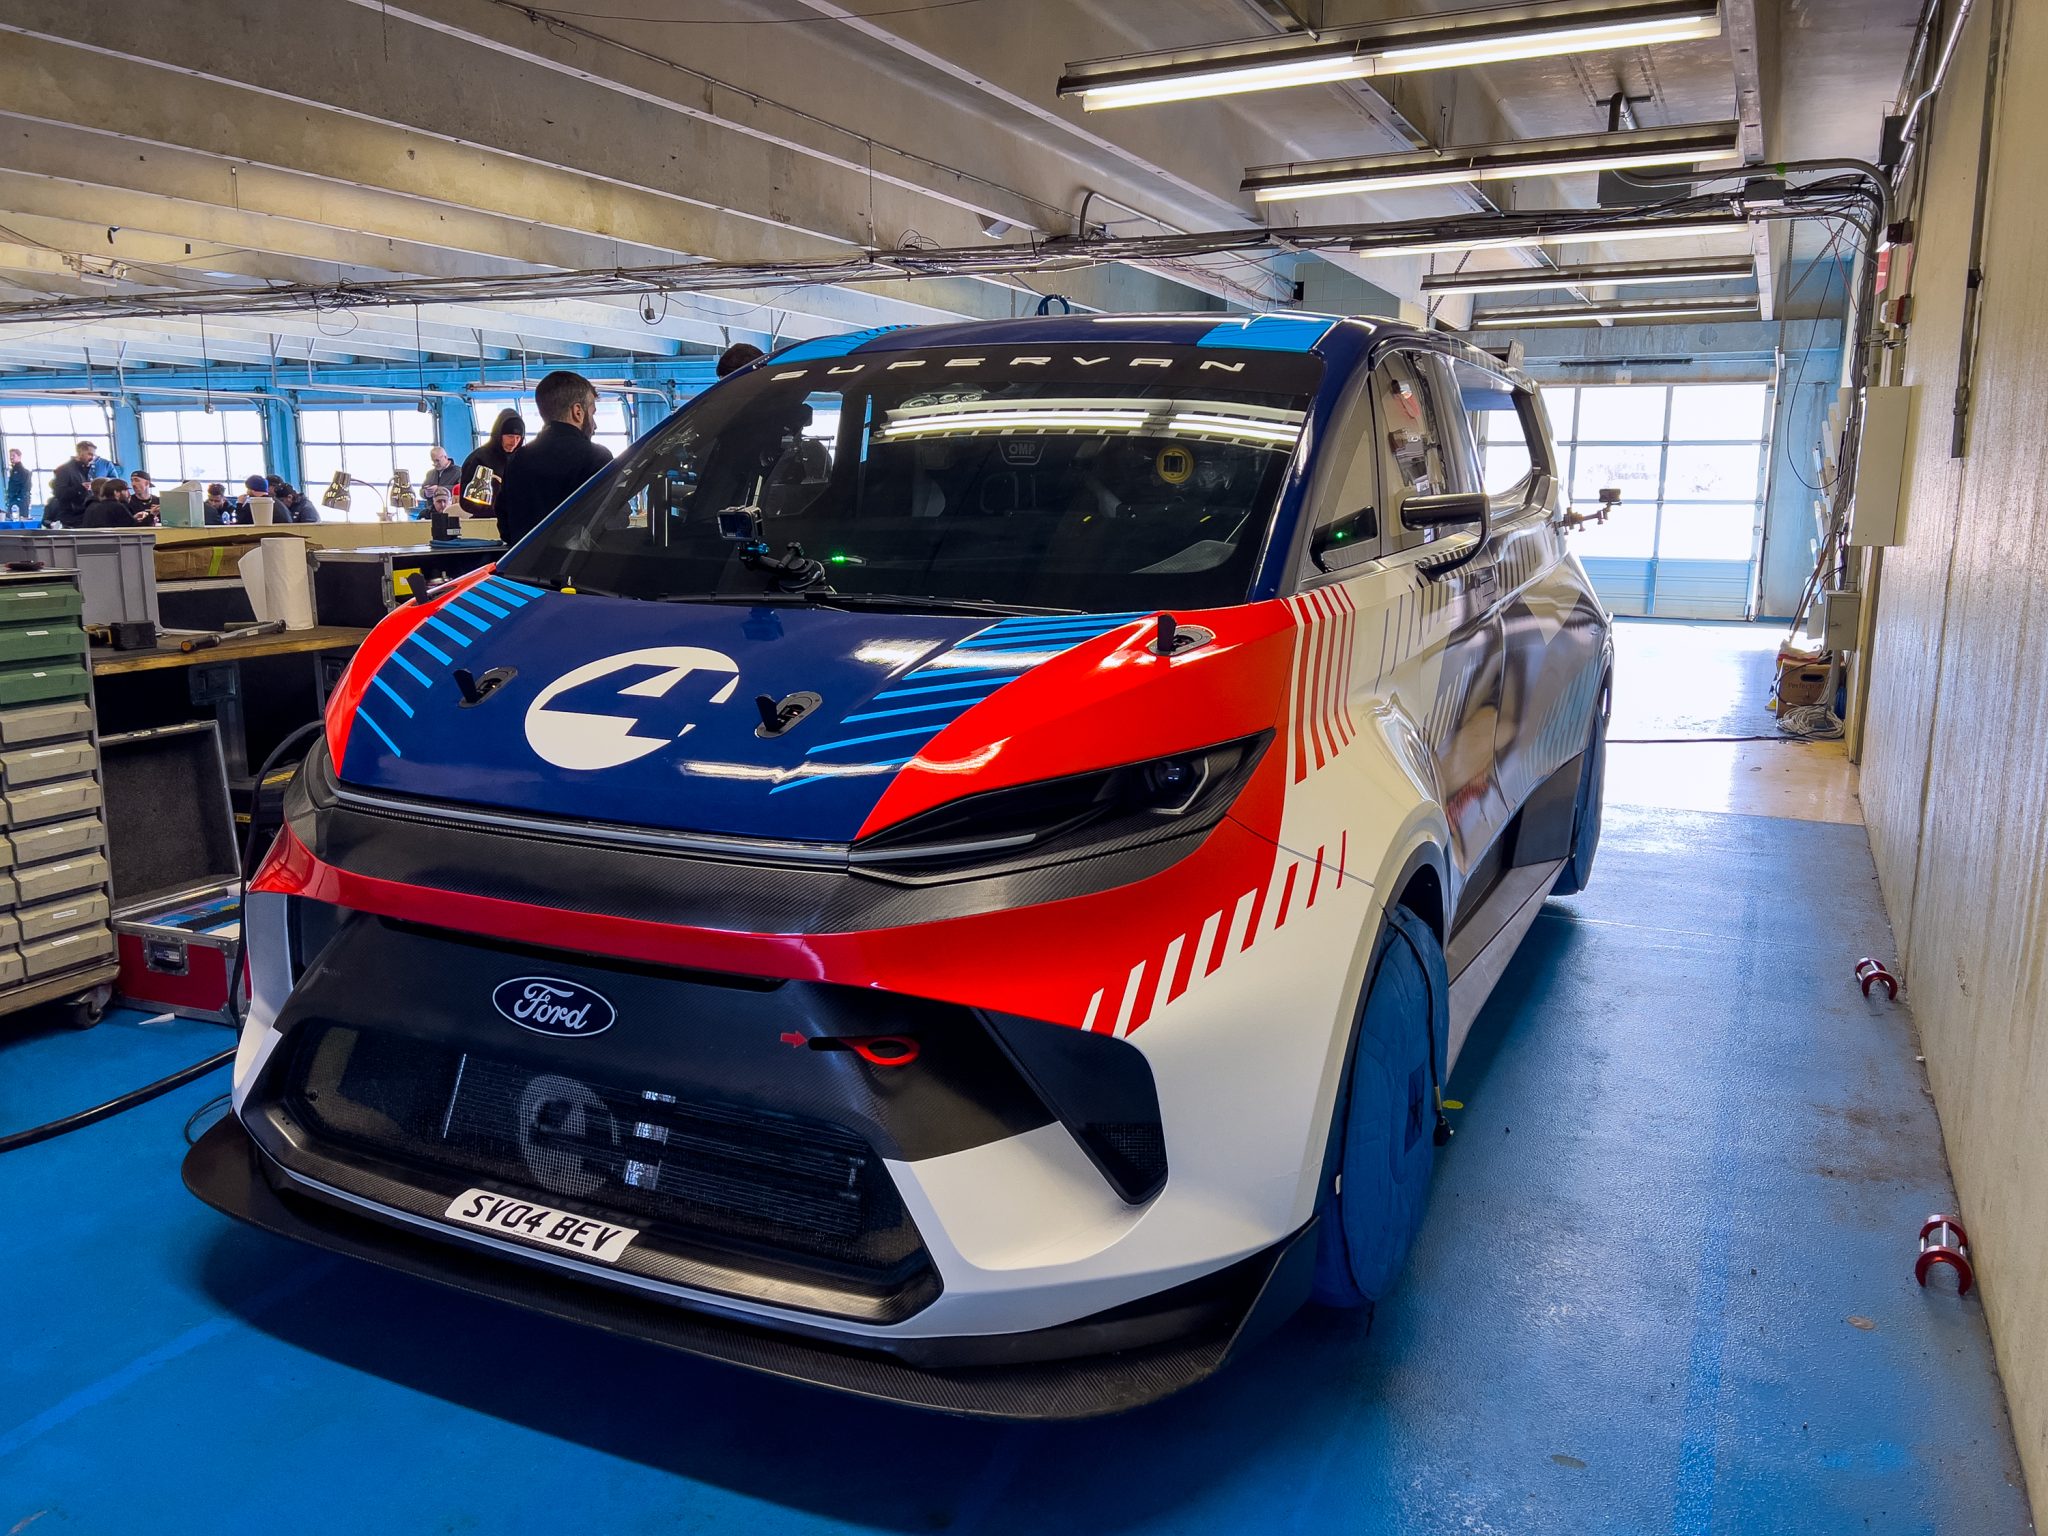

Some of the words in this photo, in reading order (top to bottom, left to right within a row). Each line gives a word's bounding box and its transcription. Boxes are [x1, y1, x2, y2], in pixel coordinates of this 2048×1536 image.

[771, 356, 1246, 381] SUPERVAN
[1008, 443, 1036, 455] OMP
[513, 982, 592, 1030] Ford
[462, 1195, 552, 1234] SV04
[545, 1216, 622, 1252] BEV
